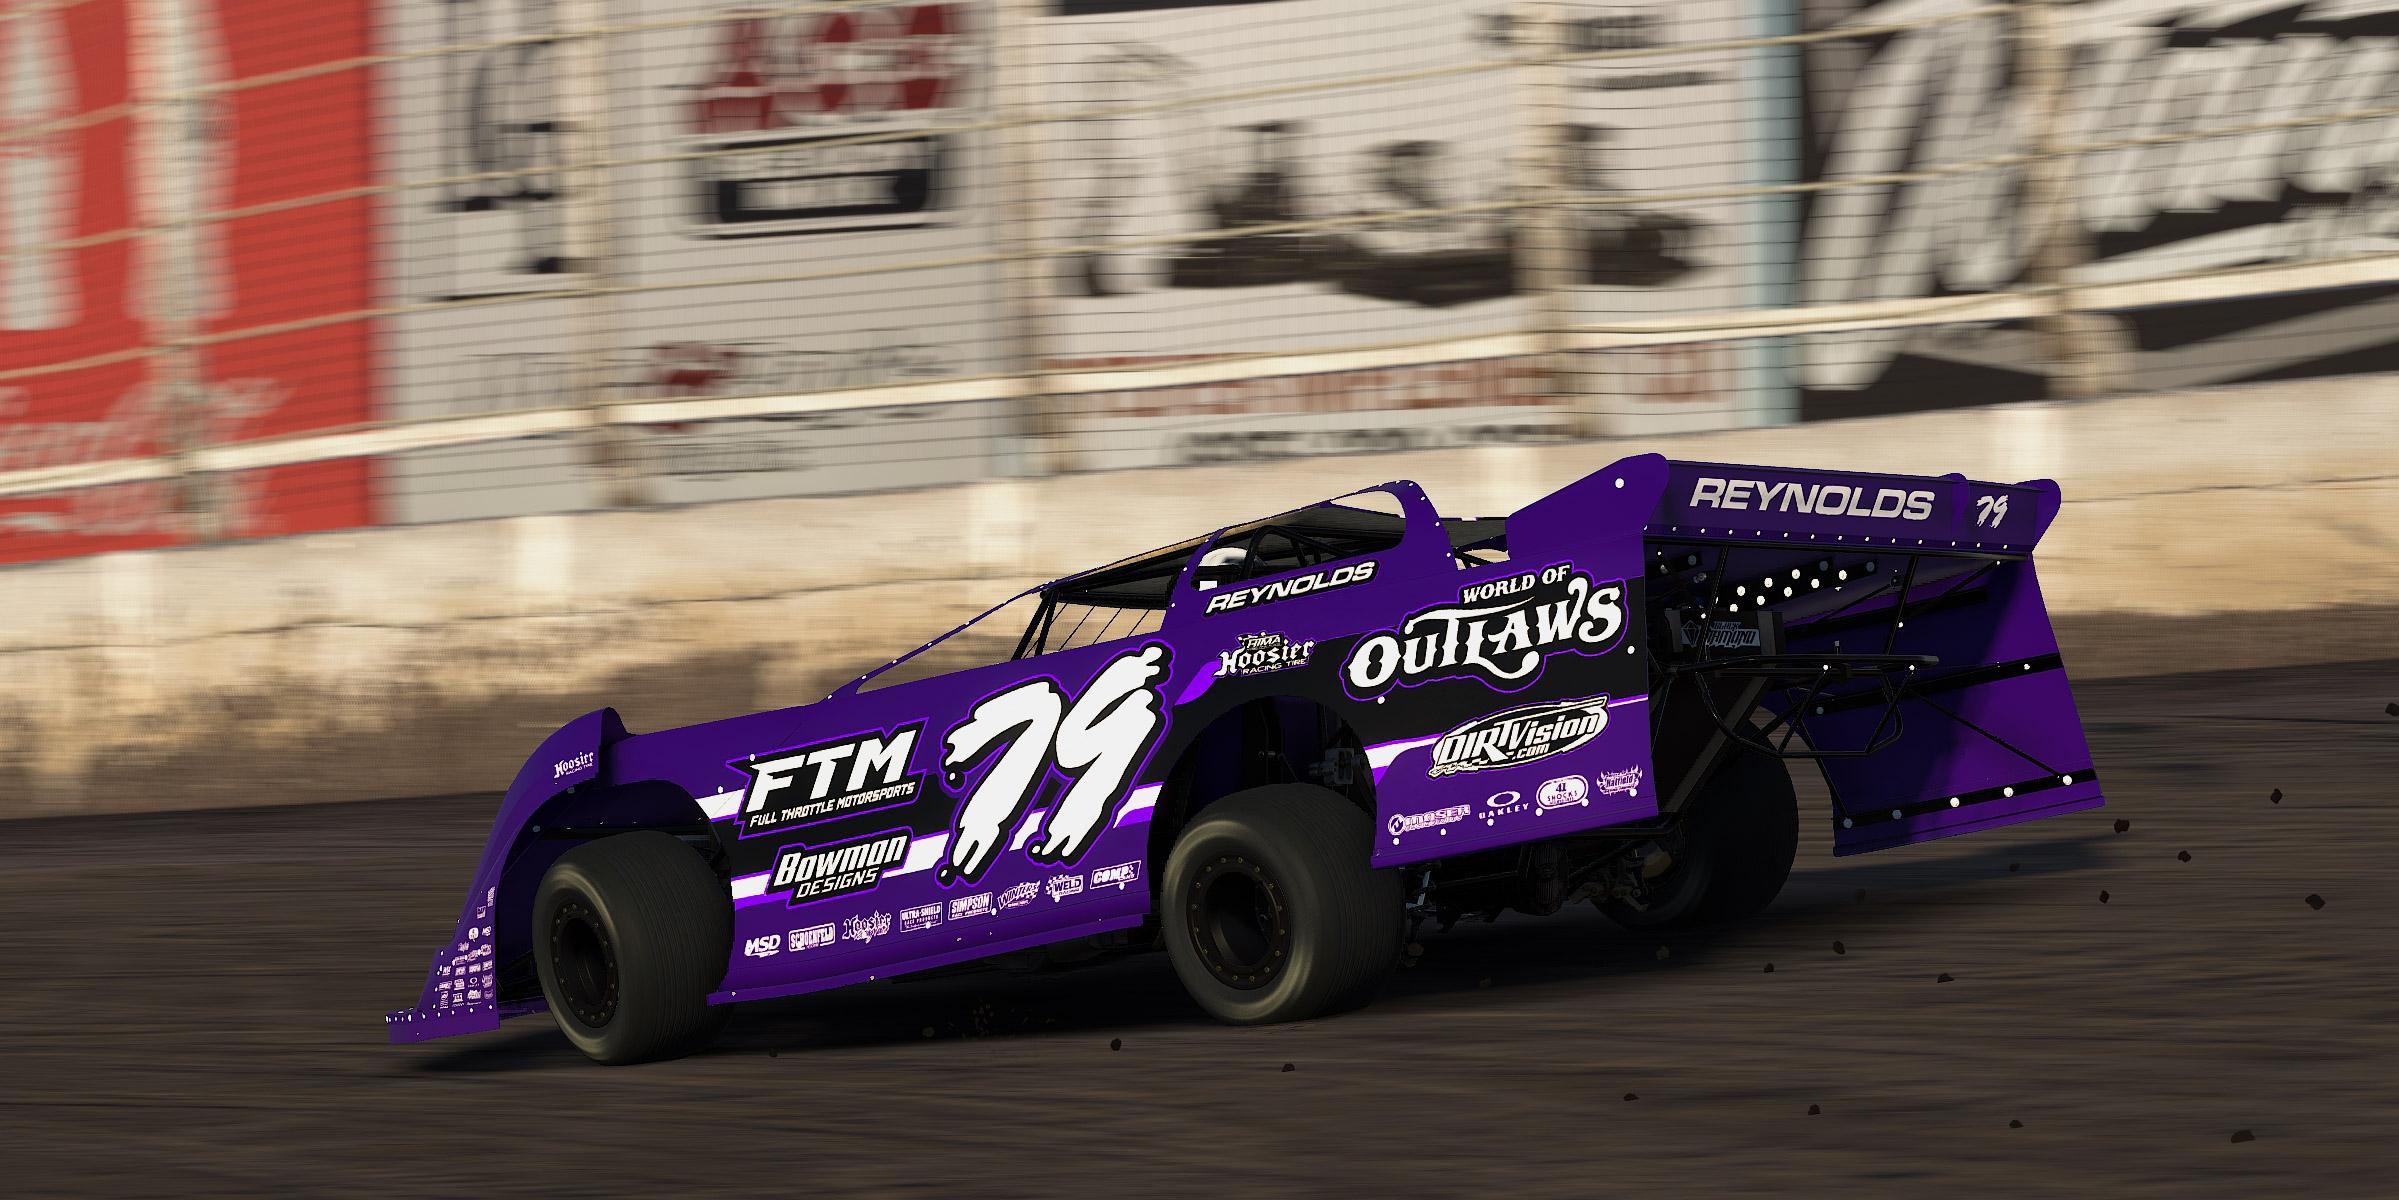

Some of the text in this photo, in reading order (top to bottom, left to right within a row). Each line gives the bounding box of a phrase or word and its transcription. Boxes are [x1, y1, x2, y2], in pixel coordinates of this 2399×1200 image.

[1690, 477, 1936, 521] REYNOLDS
[1976, 494, 2009, 529] 79
[1205, 561, 1376, 614] REYNOLDS
[1463, 564, 1571, 604] WORLD OF
[1213, 638, 1315, 677] Hoosier
[1242, 658, 1307, 675] RACING TIRE
[553, 751, 594, 779] Hoosier
[745, 729, 917, 813] FTM
[943, 646, 1163, 877] 79
[750, 781, 916, 828] FULL THROTTLE MOTORSPORTS
[1547, 789, 1578, 802] SHOCKS
[1478, 802, 1530, 820] OAKLEY
[796, 866, 880, 899] DESIGNS
[1053, 879, 1081, 893] WELD
[1093, 865, 1130, 885] COMP
[901, 905, 941, 921] ULTRA-SHIELD
[951, 894, 990, 914] SIMPSON
[744, 934, 781, 957] MSD
